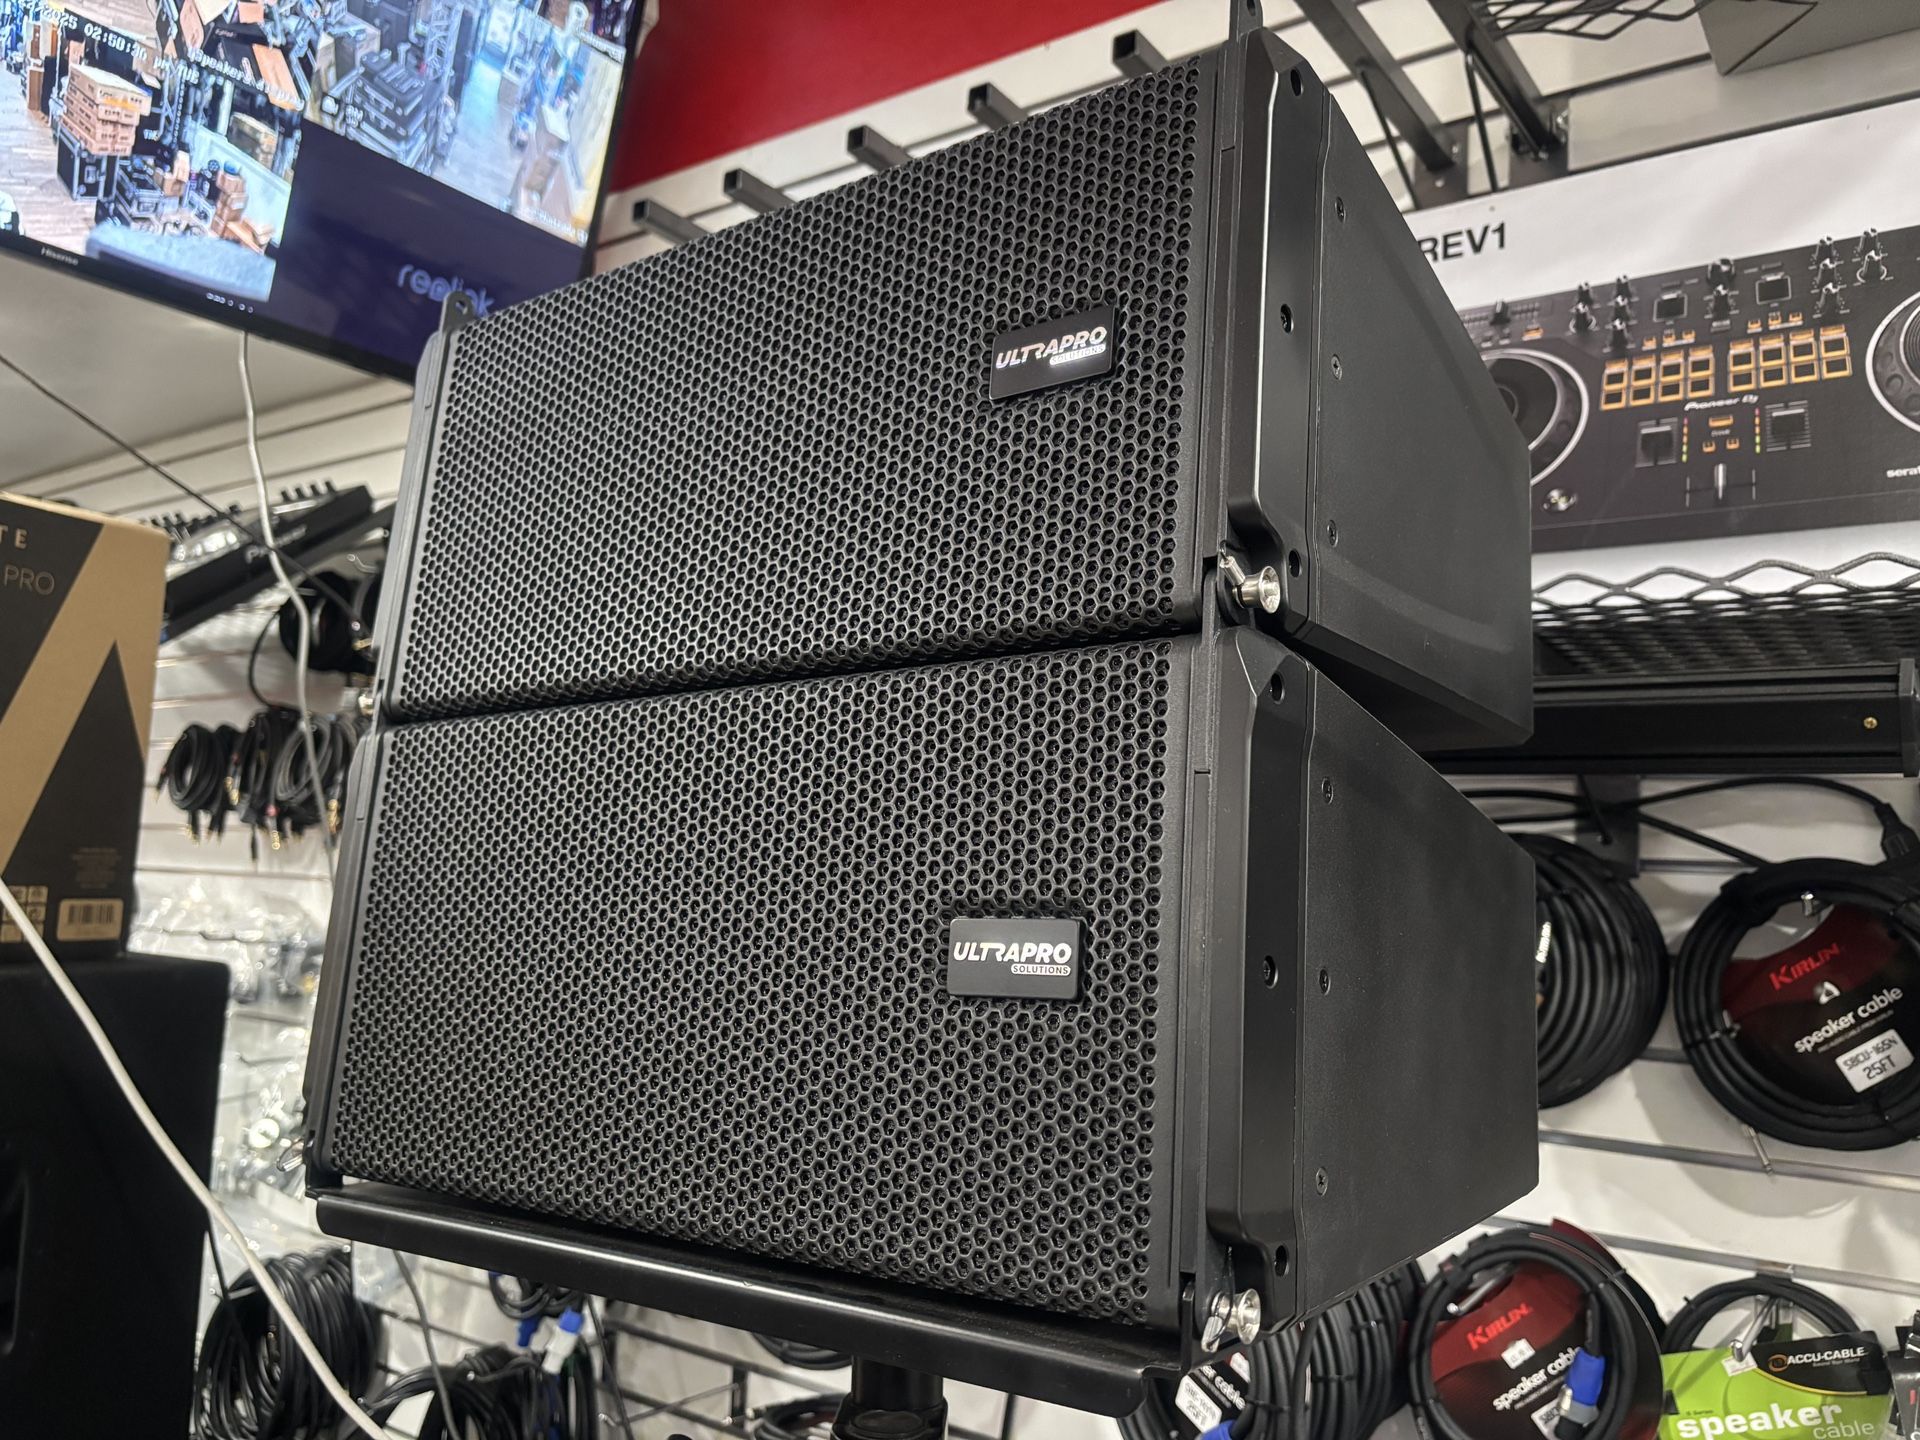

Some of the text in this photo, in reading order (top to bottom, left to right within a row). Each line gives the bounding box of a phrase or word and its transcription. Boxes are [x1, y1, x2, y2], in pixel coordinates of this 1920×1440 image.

[1417, 221, 1506, 264] REV1
[996, 326, 1107, 369] ULTRAPRO
[3, 564, 55, 595] PRO
[953, 941, 1072, 964] ULTRAPRO
[1013, 964, 1069, 975] SOLUTIONS
[1794, 1011, 1856, 1053] speaker
[1857, 987, 1904, 1018] cable
[1863, 1055, 1896, 1080] 25FT
[1787, 1347, 1866, 1365] ACCU-CABLE
[1492, 1368, 1548, 1411] speaker
[1677, 1403, 1842, 1440] speaker
[1813, 1420, 1875, 1440] cable
